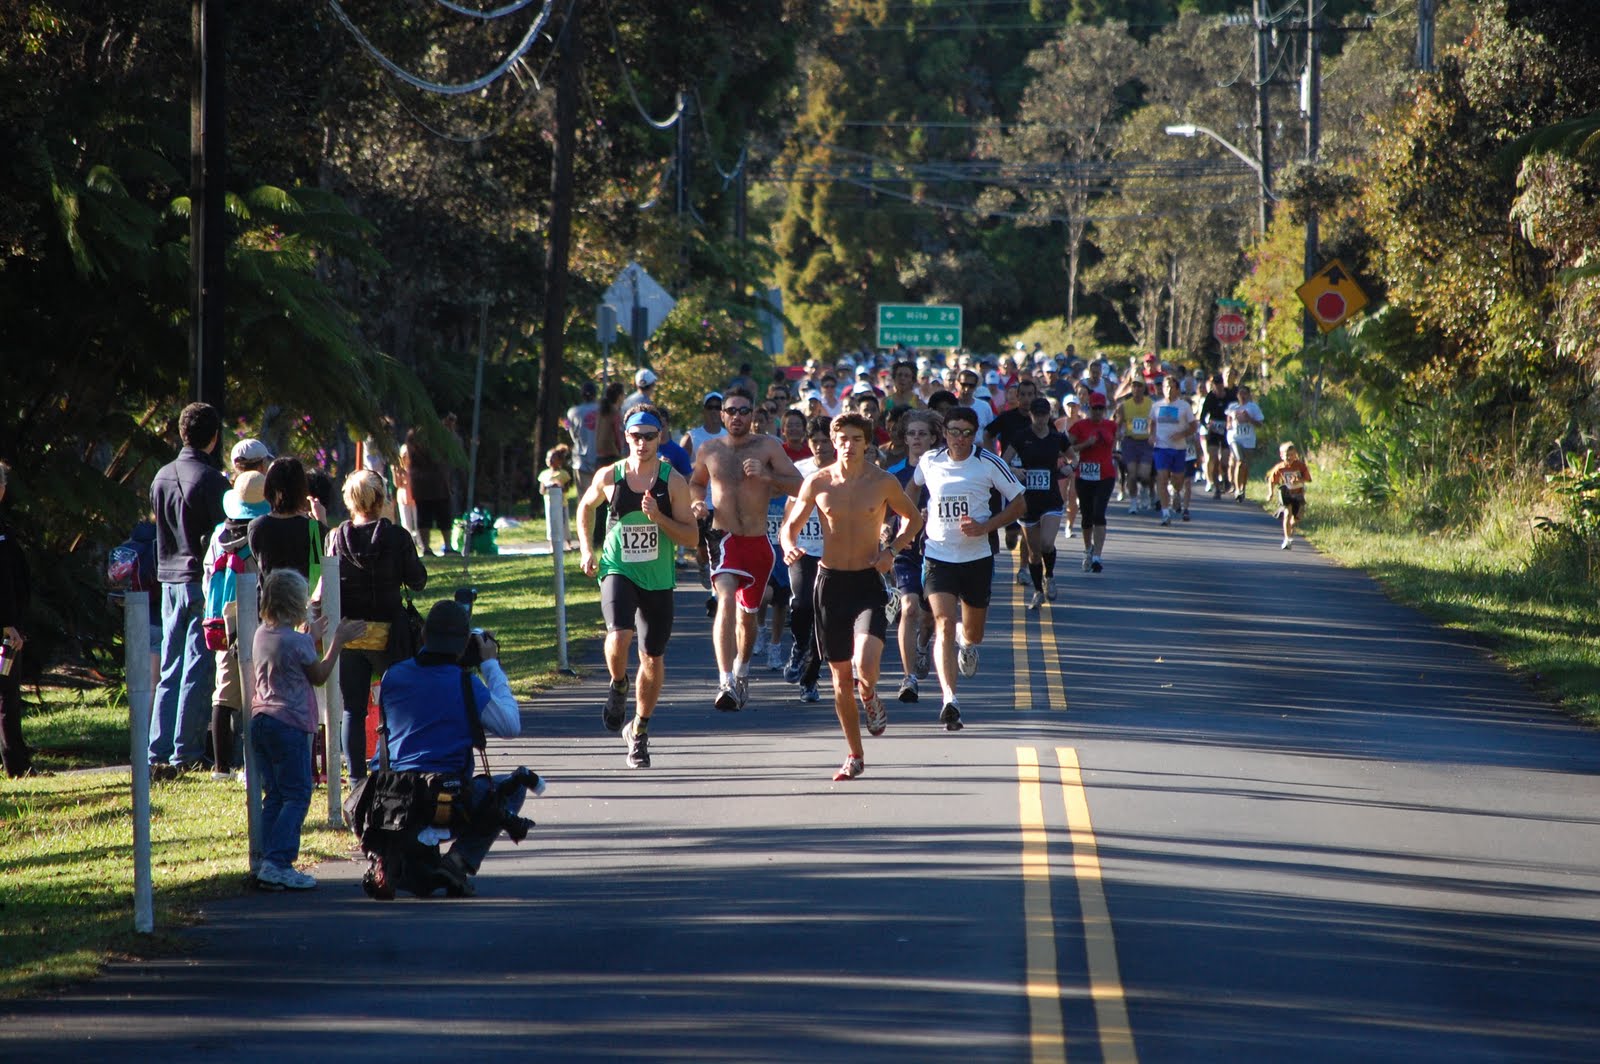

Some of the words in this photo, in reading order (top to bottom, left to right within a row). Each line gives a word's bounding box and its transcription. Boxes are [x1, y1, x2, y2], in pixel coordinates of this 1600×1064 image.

[940, 311, 956, 321] 26
[1216, 322, 1246, 336] STOP
[1080, 463, 1099, 474] 1202
[1027, 475, 1049, 487] 1193
[938, 501, 969, 518] 1169
[622, 531, 658, 549] 1228
